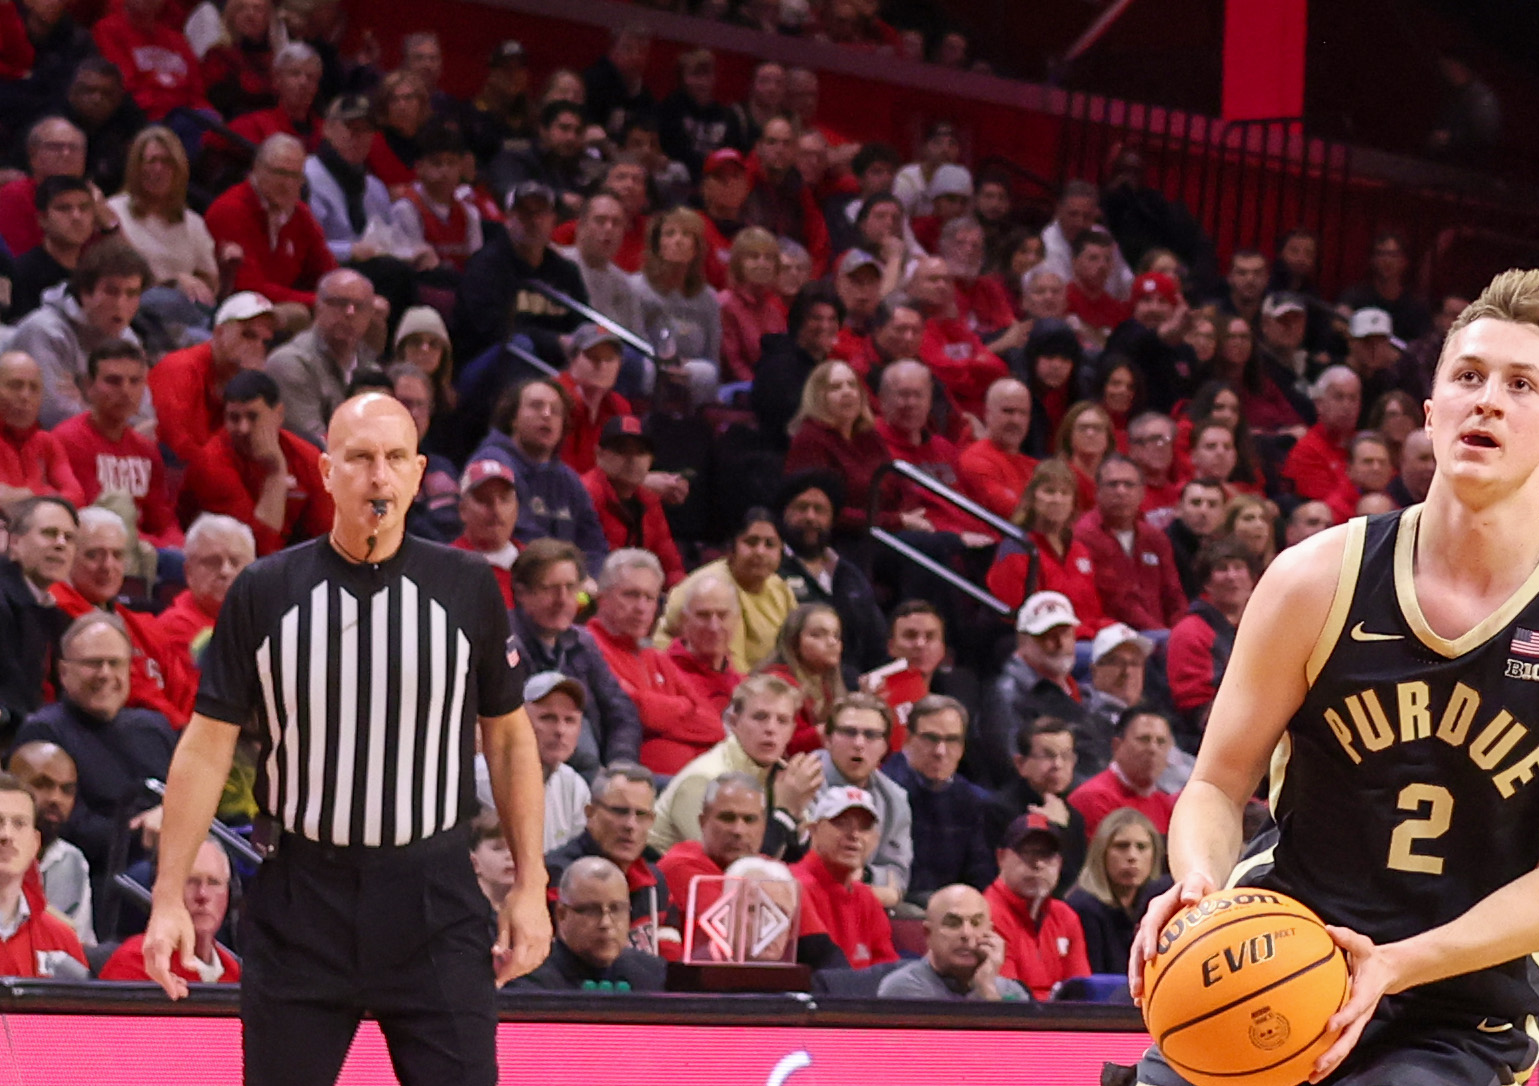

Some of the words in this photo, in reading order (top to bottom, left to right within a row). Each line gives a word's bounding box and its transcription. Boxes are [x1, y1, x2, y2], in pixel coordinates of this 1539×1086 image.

[1387, 782, 1454, 875] 2
[1157, 893, 1283, 956] Wilson
[1201, 932, 1275, 989] EVO
